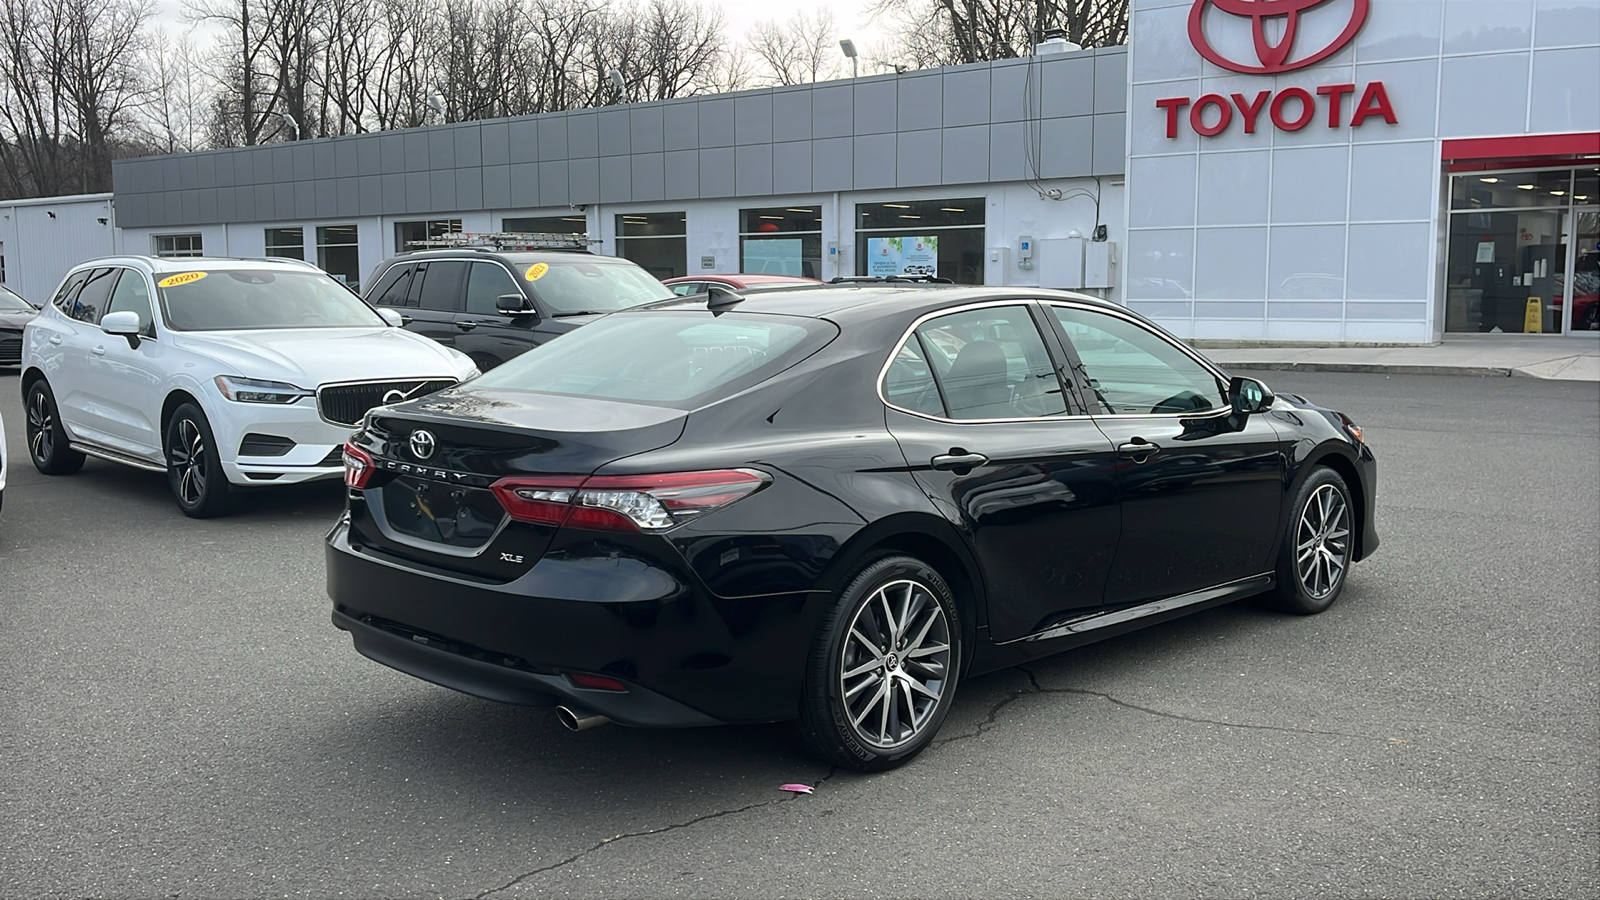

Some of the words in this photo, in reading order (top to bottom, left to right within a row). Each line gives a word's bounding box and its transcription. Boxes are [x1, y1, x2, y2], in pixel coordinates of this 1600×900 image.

[1155, 81, 1398, 138] TOYOTA
[167, 273, 199, 286] 2020
[529, 264, 546, 279] 2023
[387, 462, 467, 479] CAMRY
[499, 552, 524, 563] XLE
[837, 725, 868, 759] KINERGY
